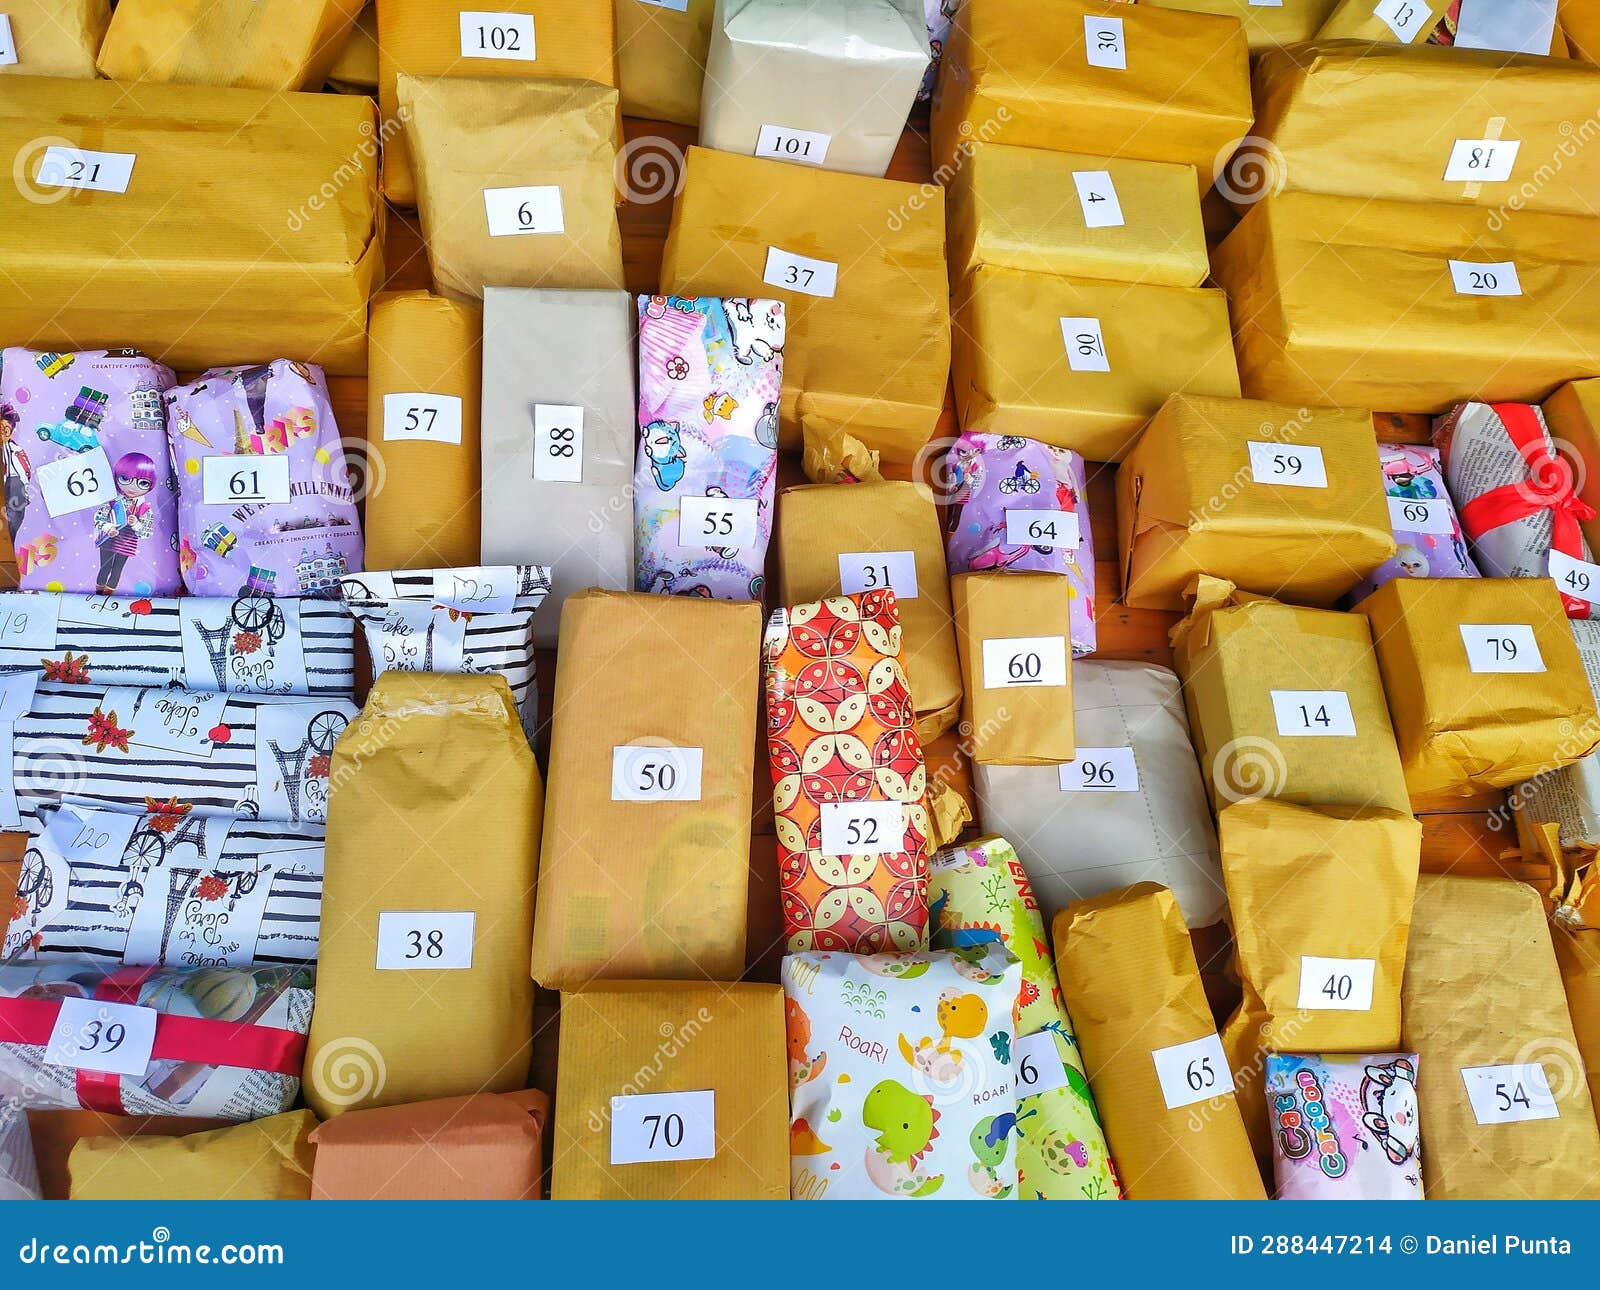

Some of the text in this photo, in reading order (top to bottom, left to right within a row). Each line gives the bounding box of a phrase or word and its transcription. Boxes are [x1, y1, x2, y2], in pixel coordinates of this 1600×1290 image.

[1393, 2, 1414, 28] 13
[477, 26, 521, 51] 102
[1097, 31, 1118, 52] 30
[773, 136, 811, 157] 101
[1468, 147, 1496, 169] 18
[66, 161, 102, 183] 21
[1087, 192, 1106, 204] 4
[517, 201, 533, 226] 6
[784, 266, 814, 288] 37
[1470, 271, 1498, 290] 20
[1076, 333, 1100, 356] 90
[404, 408, 438, 431] 57
[550, 427, 574, 458] 88
[1273, 455, 1302, 475] 59
[67, 468, 98, 496] 63
[229, 470, 261, 495] 61
[703, 512, 733, 535] 55
[1403, 504, 1429, 523] 69
[1028, 520, 1058, 540] 64
[451, 575, 500, 603] 122
[864, 566, 892, 588] 31
[1565, 570, 1590, 592] 49
[0, 610, 29, 640] 19
[382, 616, 415, 637] ake
[1486, 638, 1518, 661] 79
[1008, 653, 1042, 679] 60
[1299, 704, 1331, 728] 14
[639, 764, 676, 790] 50
[1081, 761, 1114, 784] 96
[70, 825, 110, 849] 120
[846, 817, 879, 845] 52
[405, 929, 443, 958] 38
[1321, 974, 1352, 1000] 40
[80, 1020, 126, 1054] 39
[1186, 1056, 1215, 1091] 65
[973, 1084, 1009, 1105] ROAR!
[1495, 1082, 1531, 1112] 54
[642, 1113, 684, 1149] 70
[1278, 1093, 1313, 1160] Cat
[1296, 1068, 1347, 1179] Cartoon
